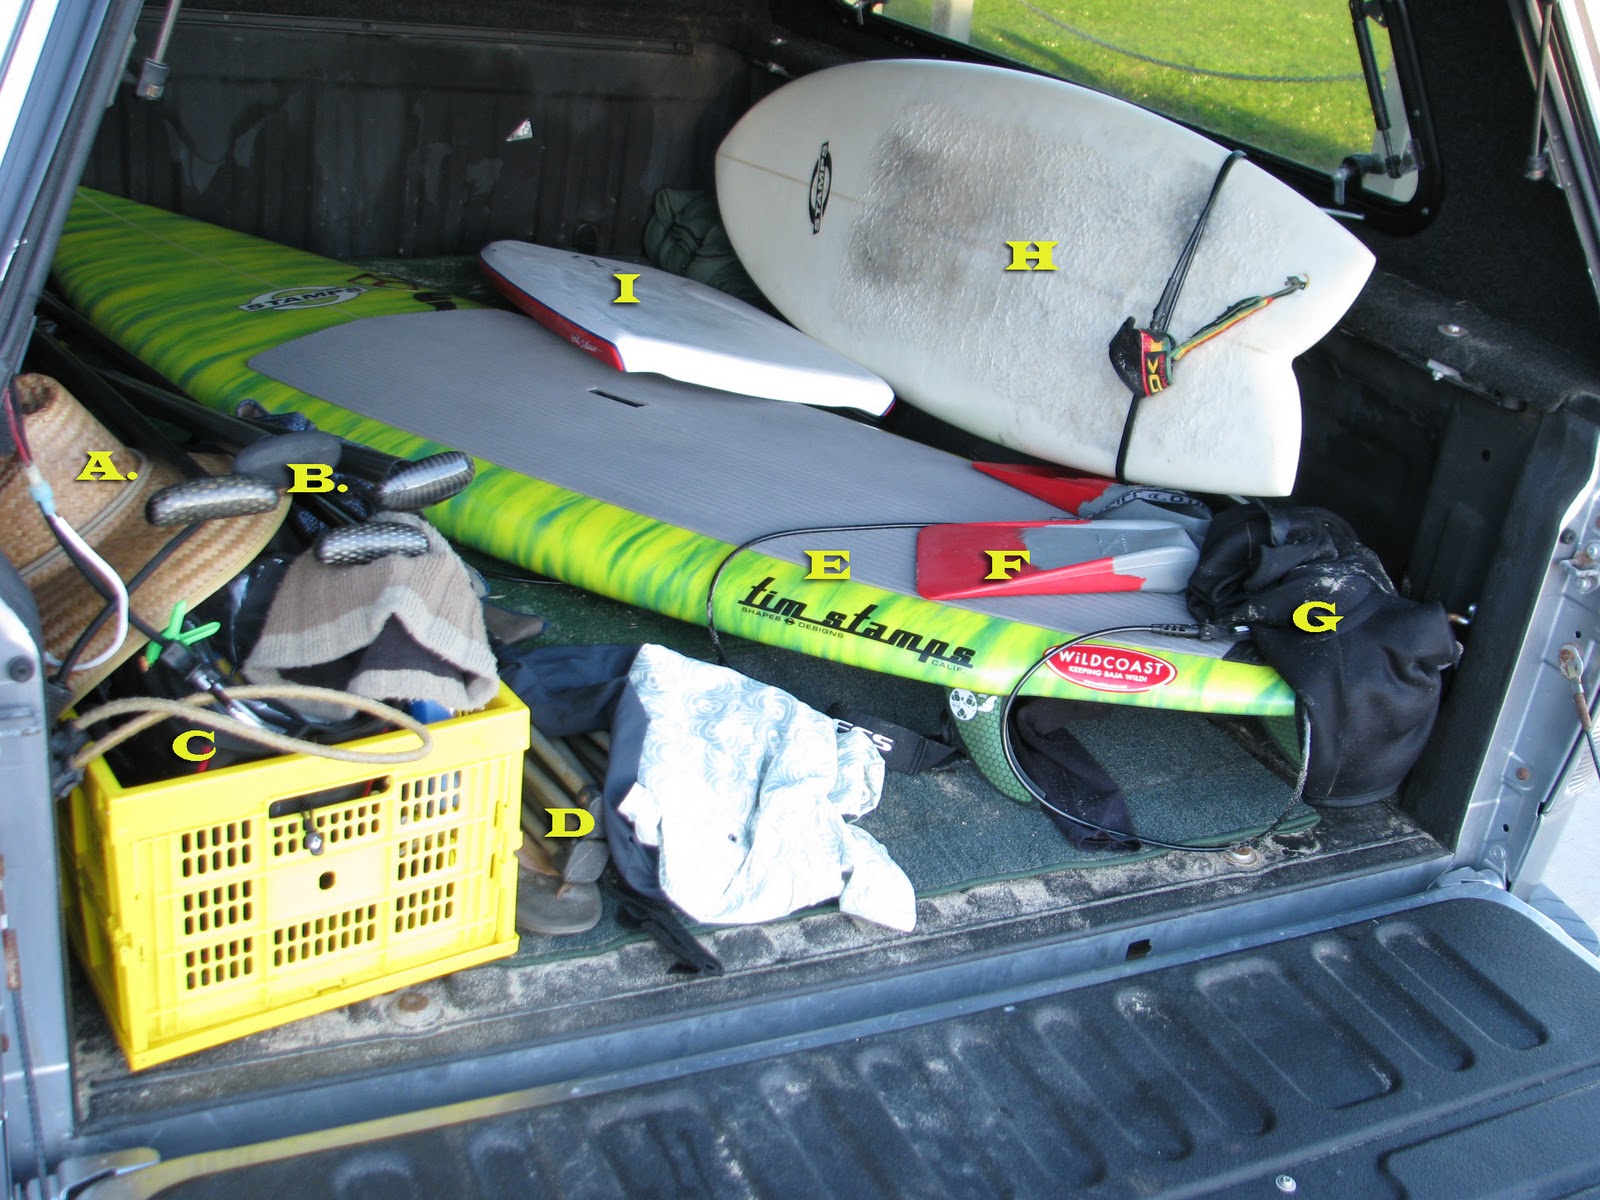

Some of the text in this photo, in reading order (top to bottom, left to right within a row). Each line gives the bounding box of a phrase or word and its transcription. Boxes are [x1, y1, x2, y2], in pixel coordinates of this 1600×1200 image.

[246, 286, 362, 311] STAMPS
[738, 577, 977, 668] tim stamps
[741, 607, 844, 639] SHAPES DESIGNS
[1068, 665, 1102, 677] KEEPING
[1104, 670, 1123, 680] BAJA
